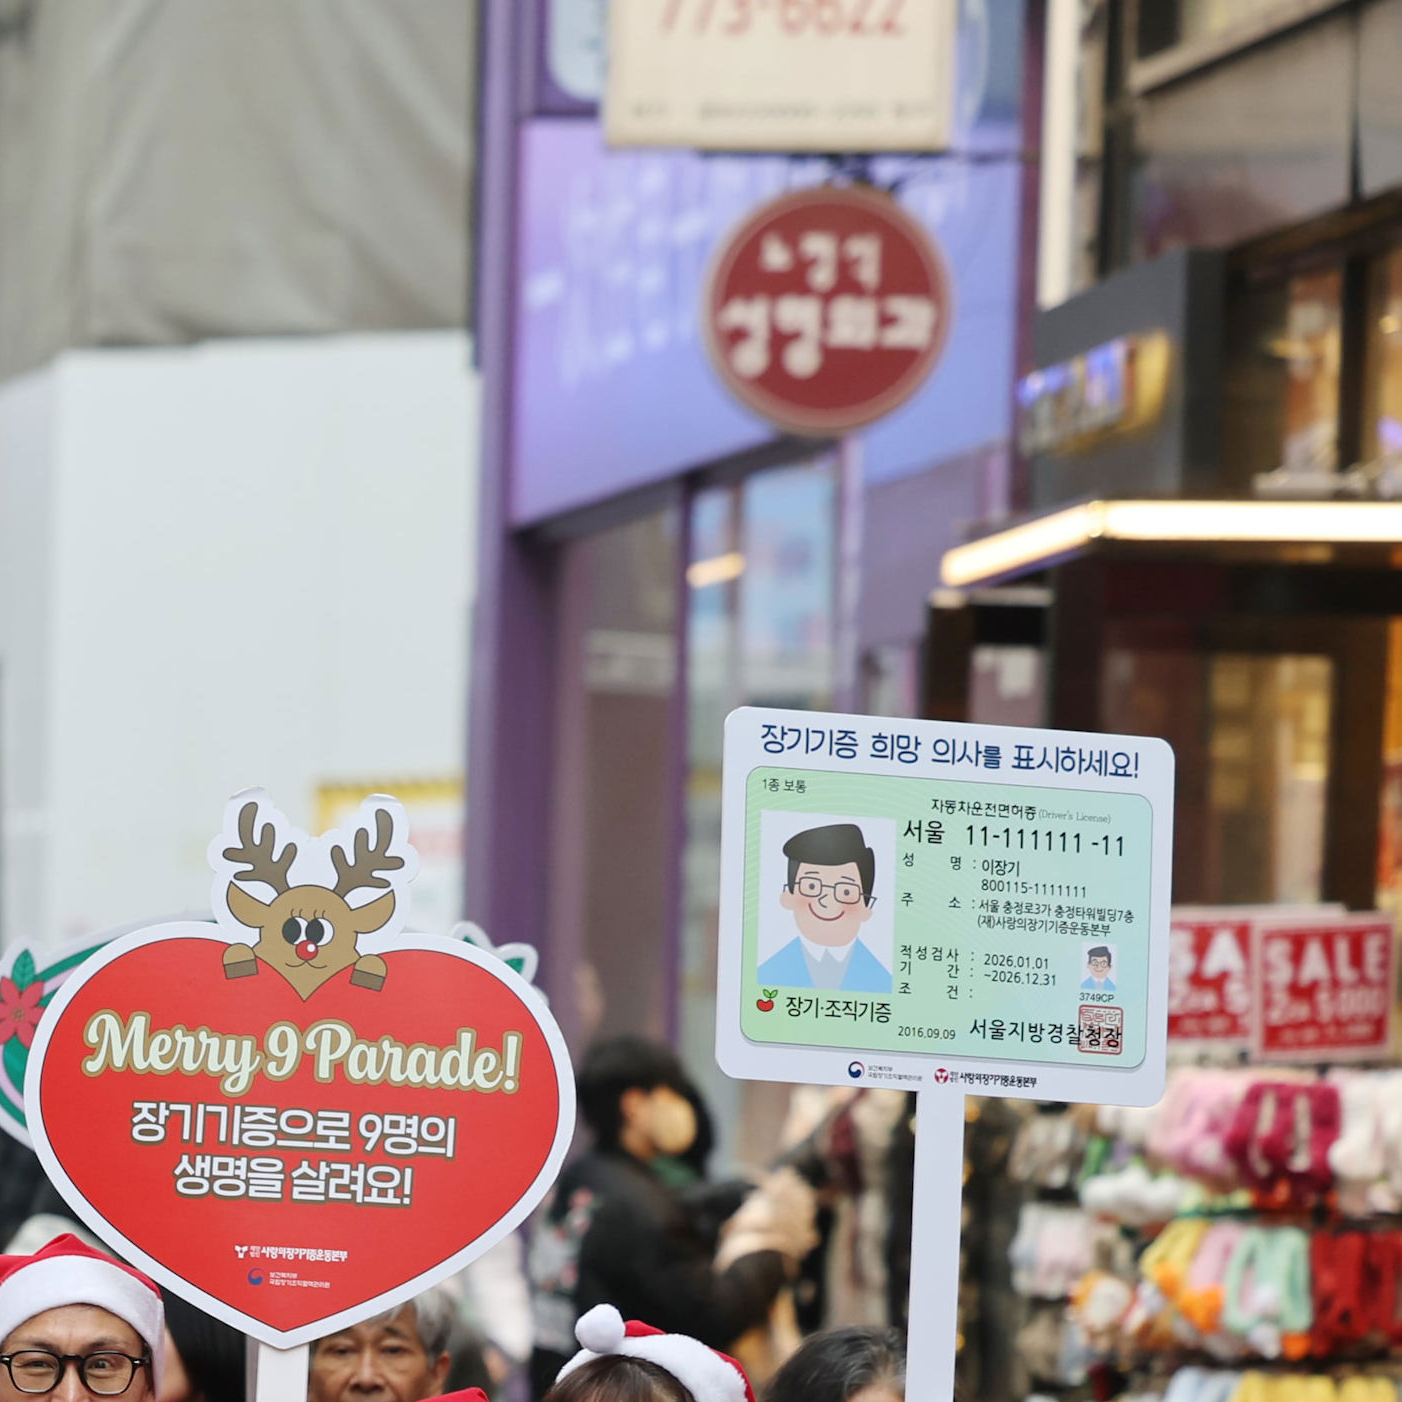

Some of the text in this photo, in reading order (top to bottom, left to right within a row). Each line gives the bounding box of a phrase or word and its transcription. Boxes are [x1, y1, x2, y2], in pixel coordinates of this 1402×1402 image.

[760, 724, 1140, 779] 장기기증 희망 의사를 표시하세요!
[762, 778, 808, 794] 1종 보통
[931, 798, 1037, 821] 자동차운전면허증
[902, 821, 946, 846] 서울
[902, 852, 1021, 878] 성 명 이장기
[980, 880, 1087, 899] 800115-1111111
[900, 893, 914, 908] 주
[948, 896, 962, 909] 소
[978, 900, 1000, 914] 서울
[1003, 902, 1051, 918] 충정로3가
[983, 953, 1049, 970] 2026.01.01
[1265, 931, 1386, 987] SALE
[983, 970, 1057, 986] ~2026.12.31
[898, 1025, 956, 1041] 2016.09.09
[969, 1019, 1123, 1048] 서울지방경찰청장
[83, 1012, 523, 1095] Merry 9 Parade!
[131, 1101, 456, 1159] 장기기증으로 9명의
[172, 1153, 414, 1206] 생명을 살려요!
